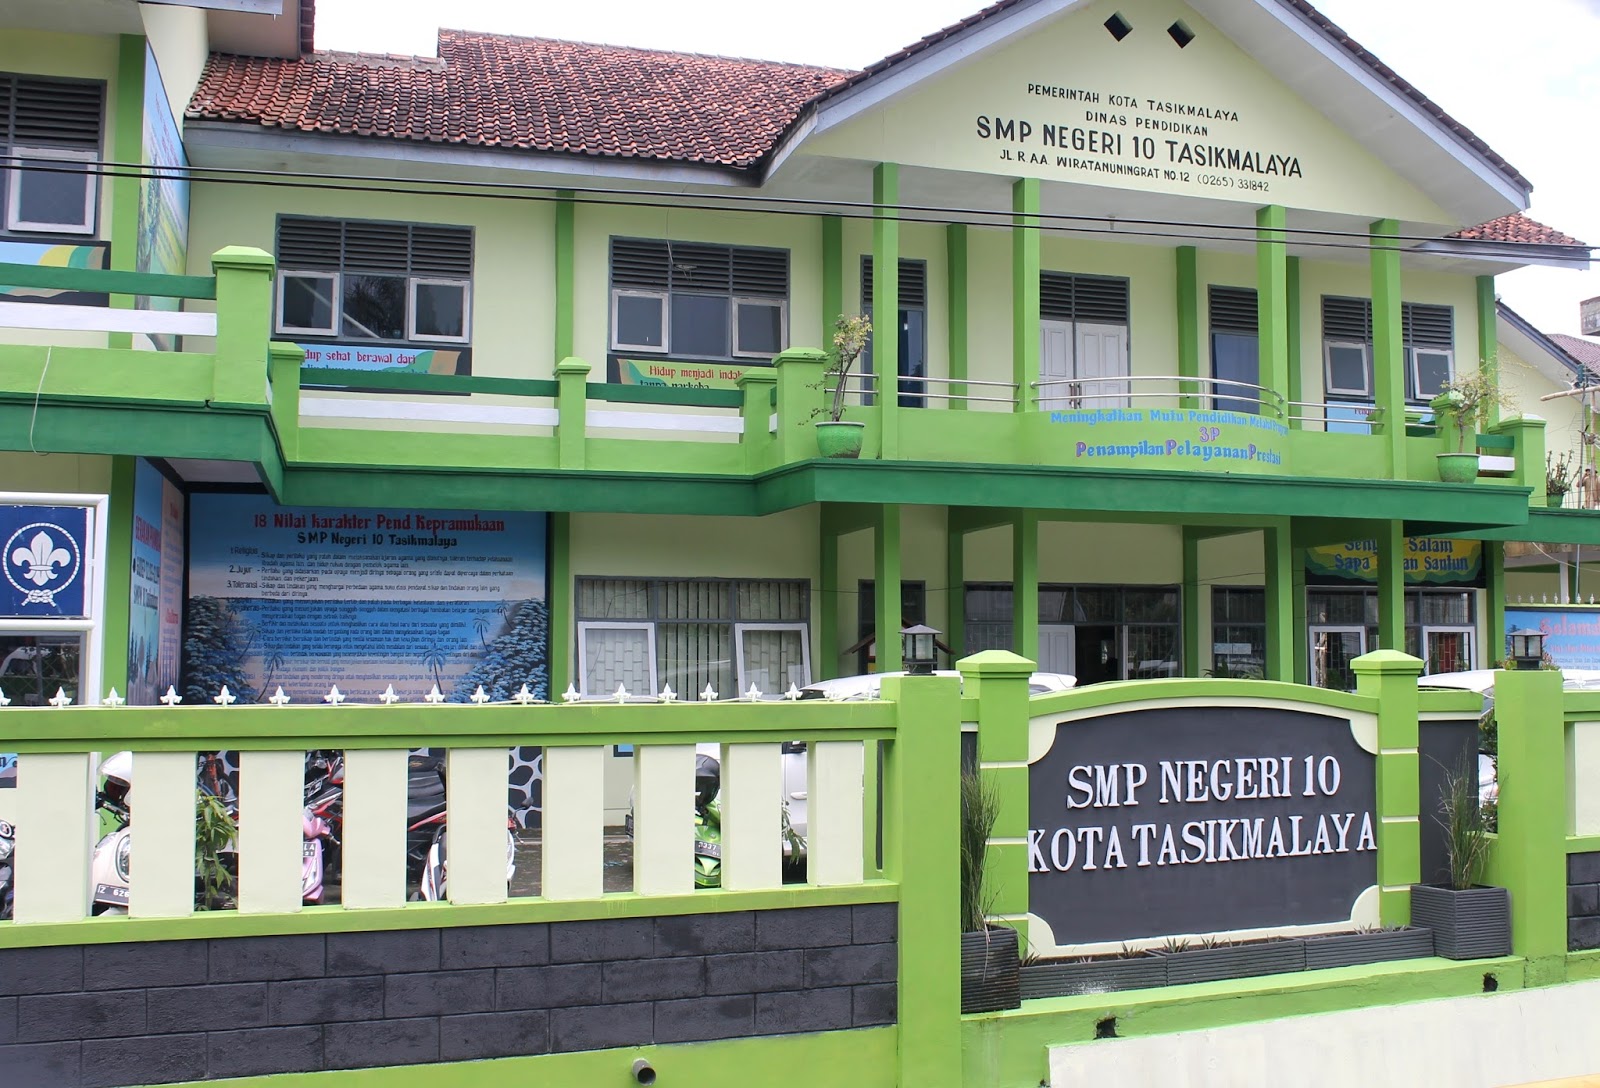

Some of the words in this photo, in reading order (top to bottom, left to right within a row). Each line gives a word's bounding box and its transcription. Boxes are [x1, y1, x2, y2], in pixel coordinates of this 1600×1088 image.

[1028, 83, 1099, 103] PEMERINTAH
[1109, 94, 1138, 108] KOTA
[1147, 99, 1239, 122] TASIKMALAYA
[1086, 110, 1127, 126] DINAS
[1136, 117, 1208, 136] PENDIDIKAN
[977, 115, 1032, 143] SMP
[1043, 124, 1121, 156] NEGERI
[1132, 136, 1155, 159] 10
[1165, 140, 1302, 178] TASIKMALAYA
[1056, 156, 1159, 179] WIRATANUNINGRAT
[1197, 173, 1234, 188] (0265)
[1238, 178, 1270, 192] 331842
[326, 350, 350, 361] sehat
[357, 352, 392, 364] berawal
[396, 354, 416, 364] dari
[649, 365, 676, 379] Hidup
[680, 369, 714, 381] menjadi
[1050, 409, 1142, 426] Meningkatkan
[1150, 410, 1184, 422] Mutu
[1188, 410, 1247, 425] Pendidikan
[1076, 441, 1165, 458] Penampilan
[1166, 439, 1248, 462] Pelayanan
[1248, 443, 1281, 465] Prestasi
[254, 513, 267, 528] 18
[274, 512, 306, 529] Nilai
[331, 534, 367, 548] Negeri
[389, 534, 458, 550] Tasikmalaya
[1408, 538, 1453, 553] Salam
[1334, 554, 1370, 572] Sapa
[1424, 555, 1469, 572] Santun
[1067, 763, 1148, 809] SMP
[1159, 756, 1292, 804] NEGERI
[1302, 755, 1341, 796] 10
[1028, 825, 1128, 873] KOTA
[1132, 811, 1378, 866] TASIKMALAYA
